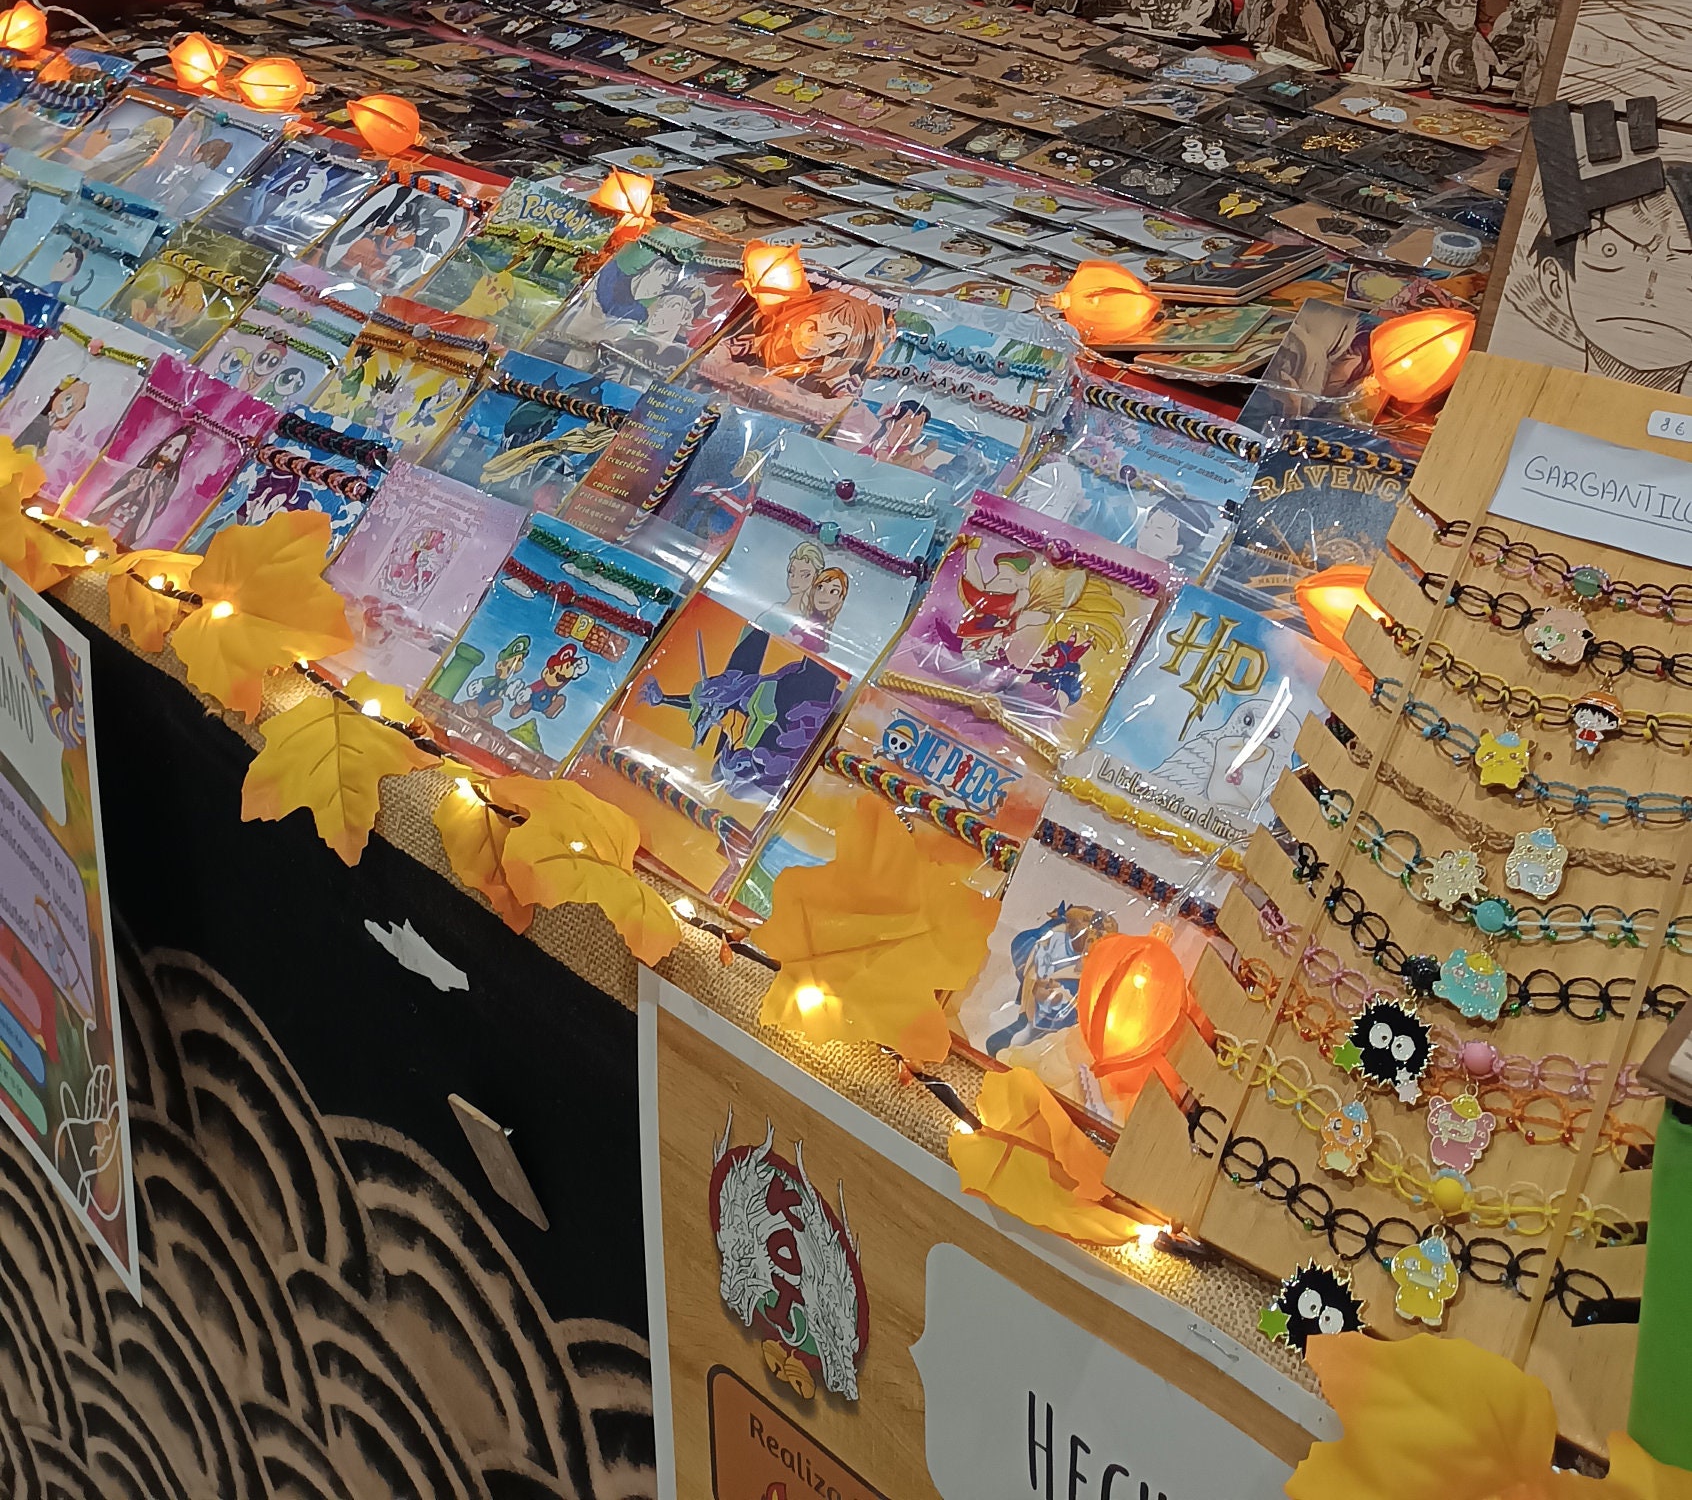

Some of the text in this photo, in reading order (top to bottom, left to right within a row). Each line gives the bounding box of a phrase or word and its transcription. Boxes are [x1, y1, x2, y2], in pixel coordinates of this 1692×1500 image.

[0, 656, 33, 744] ANO
[1099, 757, 1115, 782] La
[1181, 805, 1198, 823] en
[1197, 807, 1214, 830] el
[749, 1412, 858, 1500] Realiza
[1029, 1390, 1167, 1500] HE
